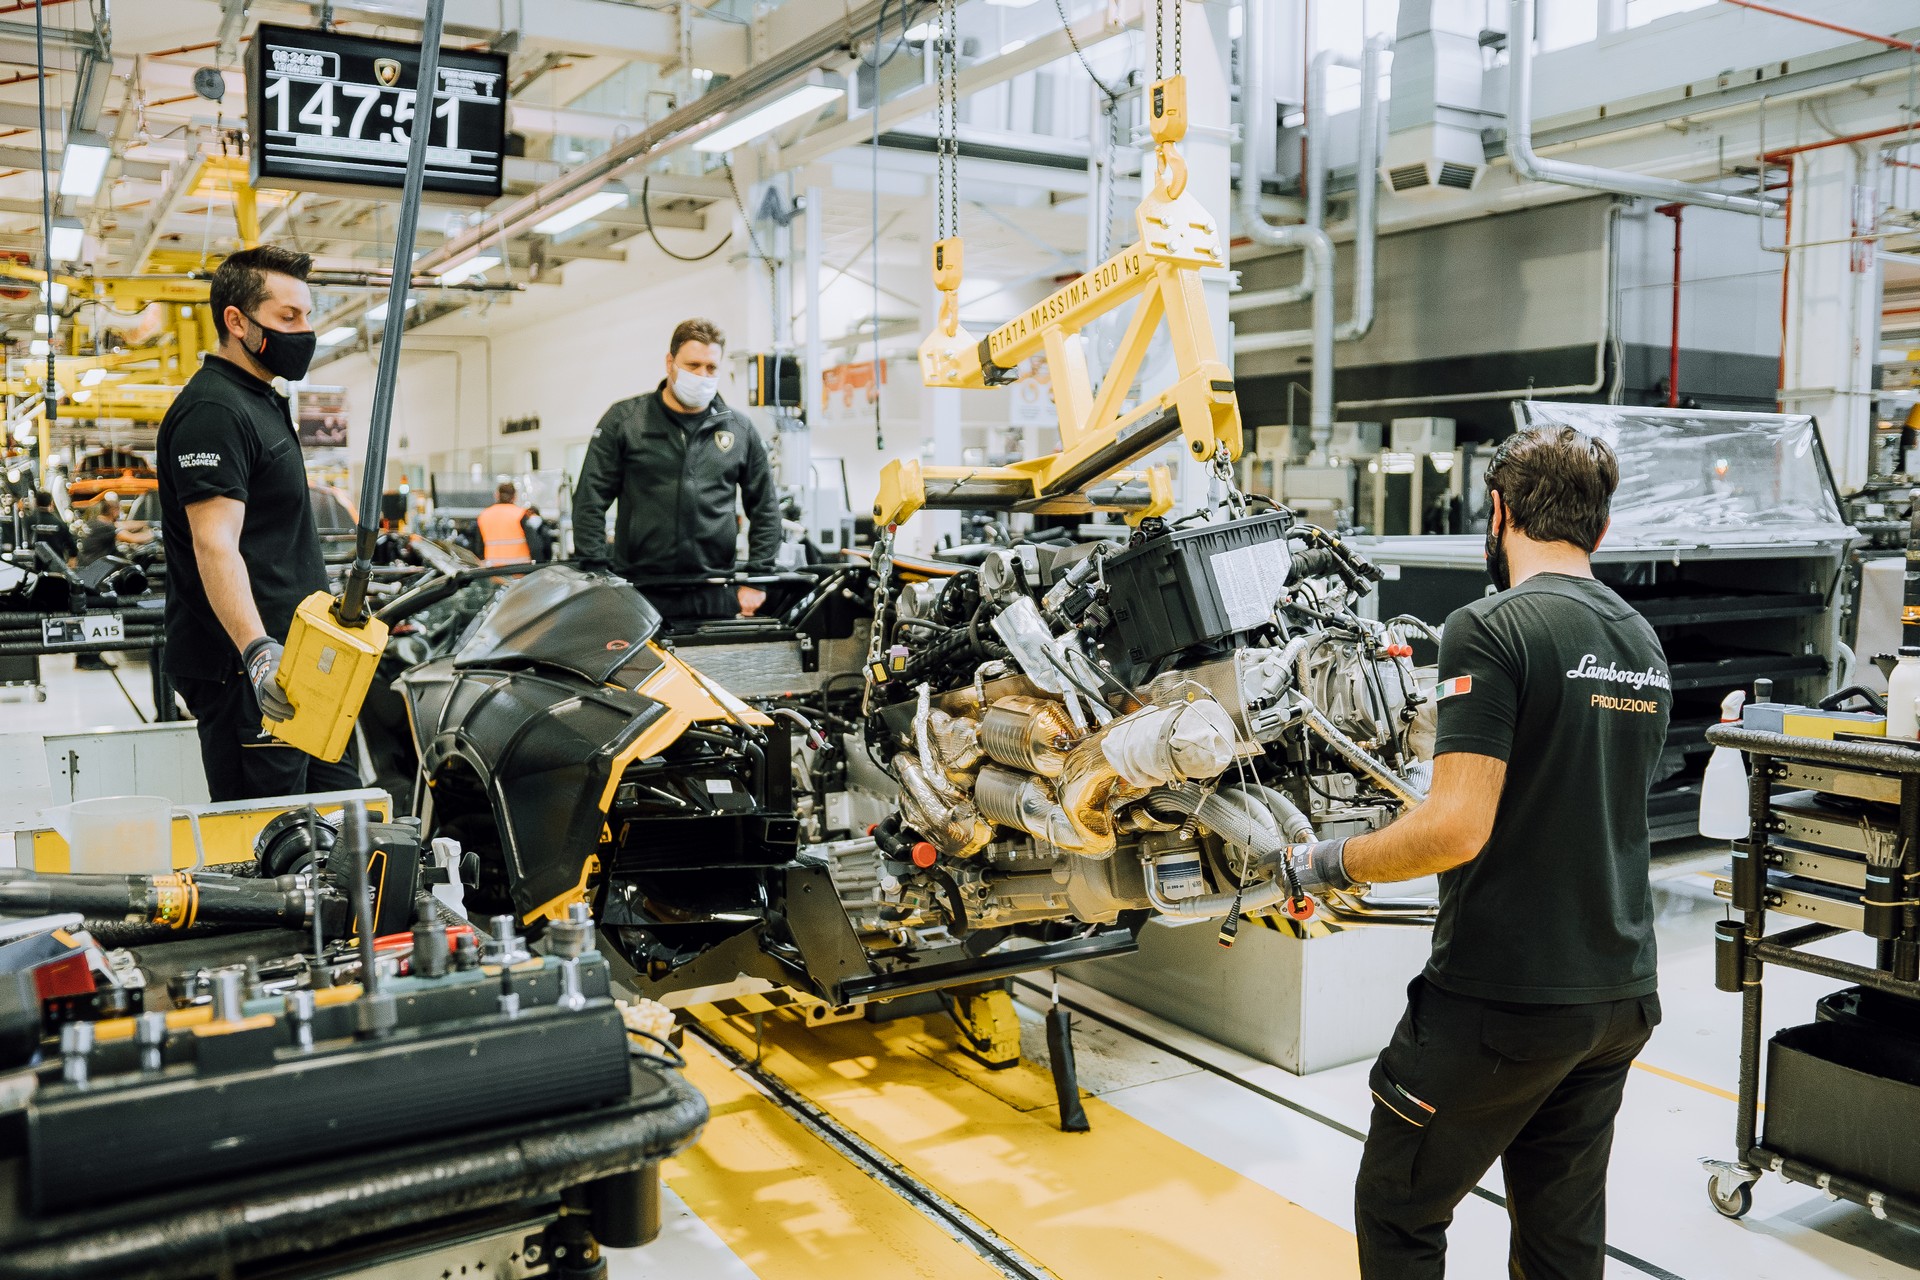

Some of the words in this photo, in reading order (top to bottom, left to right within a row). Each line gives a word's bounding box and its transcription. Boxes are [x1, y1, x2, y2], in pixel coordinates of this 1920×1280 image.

[265, 76, 460, 149] 147:51
[991, 319, 1027, 354] RTATA
[1031, 282, 1089, 330] MASSIMA
[1094, 263, 1119, 292] 500
[1124, 253, 1141, 276] kg
[180, 459, 218, 469] BOLOGNESE
[196, 452, 221, 461] AGATA
[92, 626, 120, 638] A15
[1591, 694, 1658, 714] PRODUZIONE
